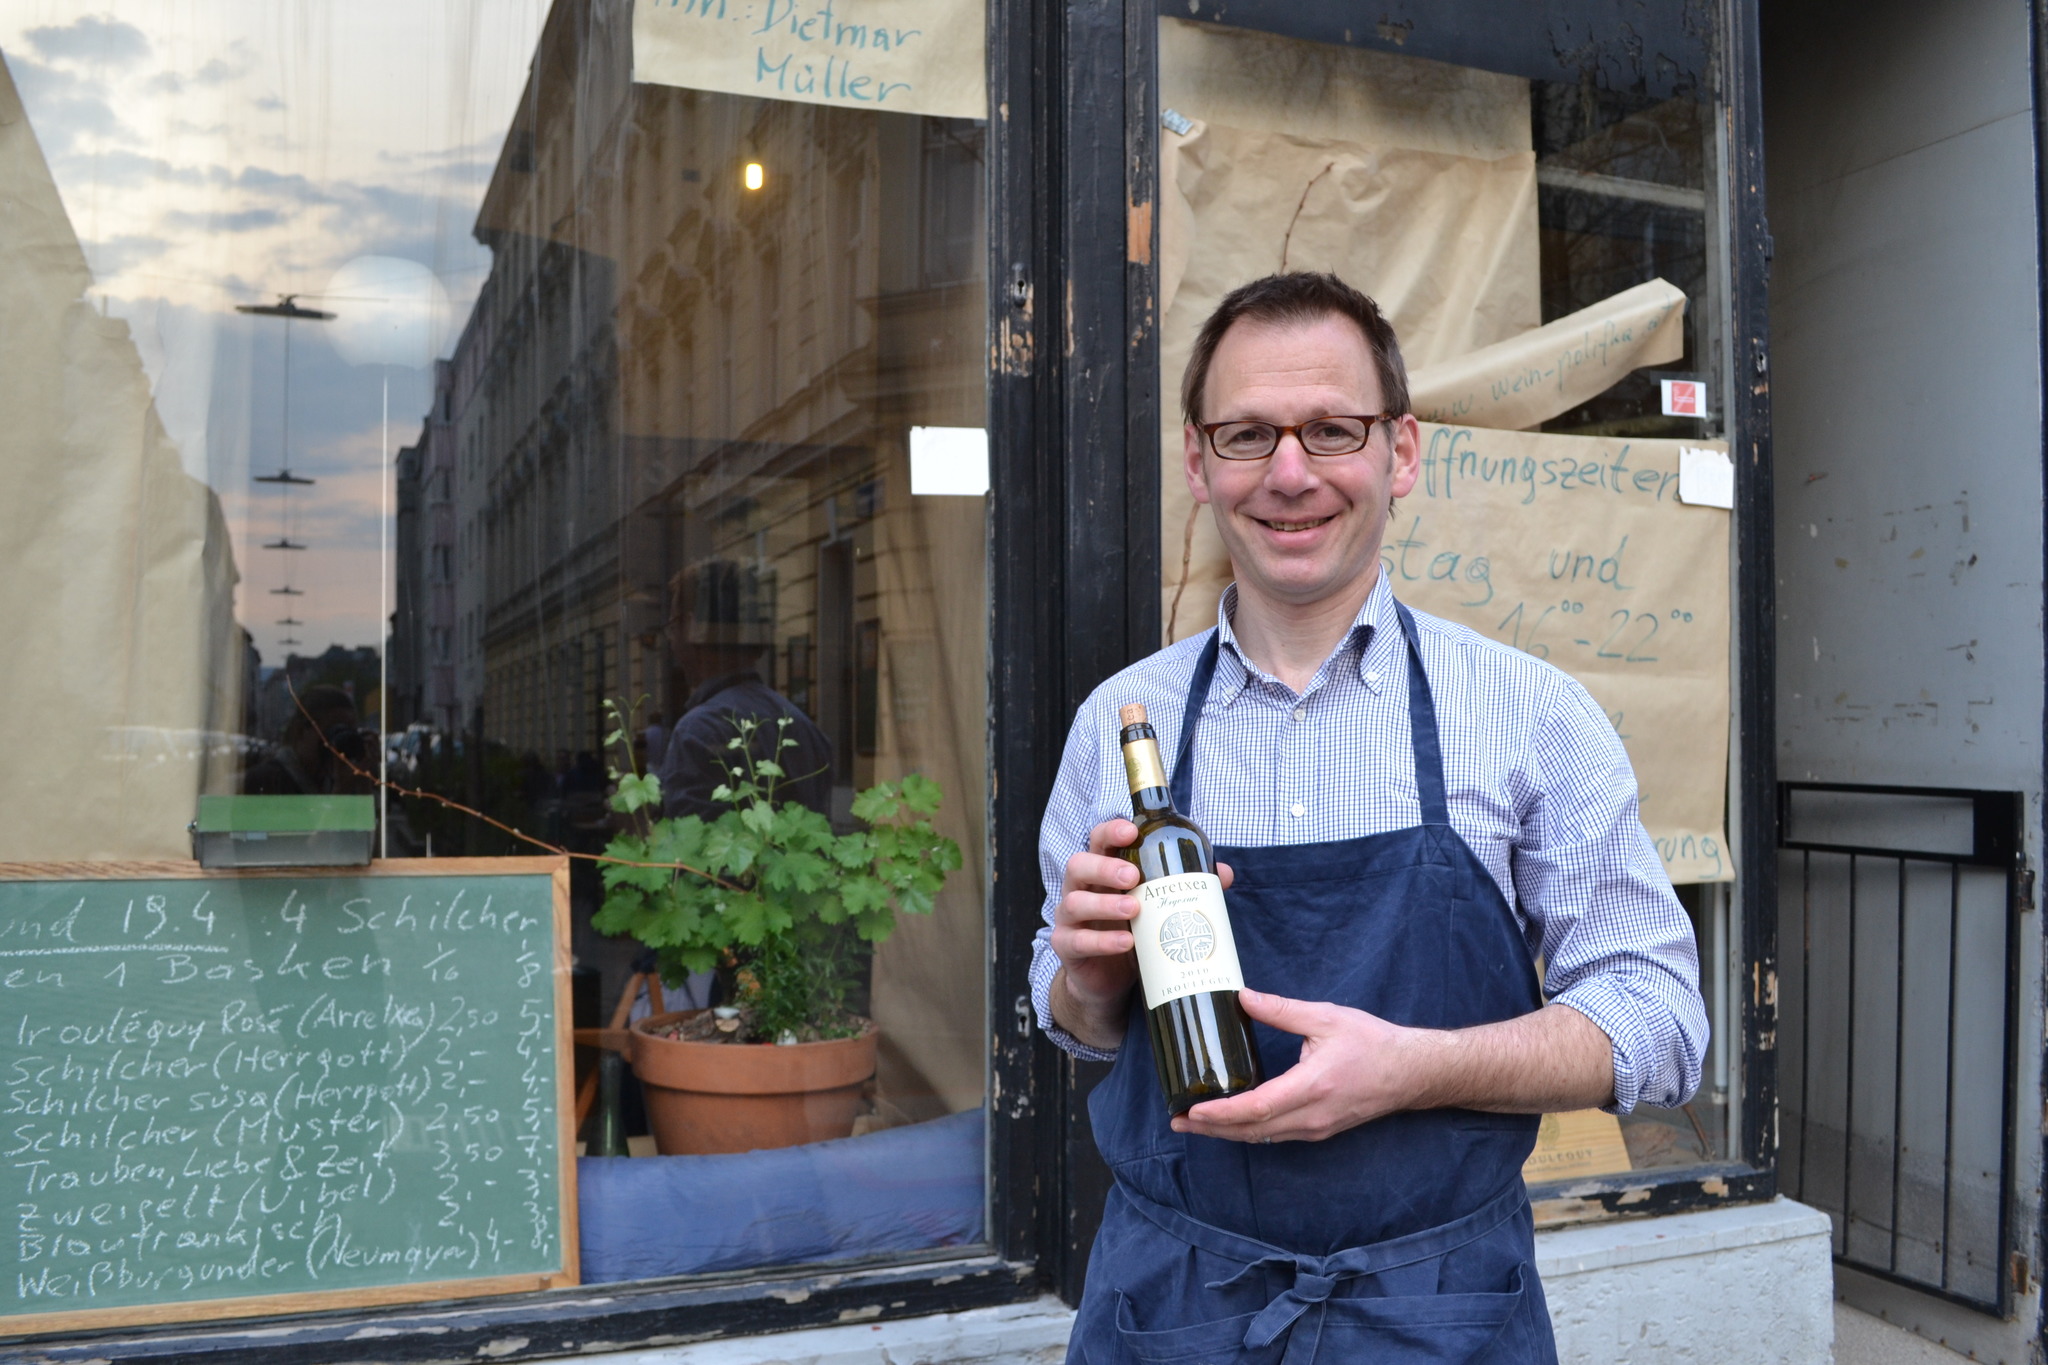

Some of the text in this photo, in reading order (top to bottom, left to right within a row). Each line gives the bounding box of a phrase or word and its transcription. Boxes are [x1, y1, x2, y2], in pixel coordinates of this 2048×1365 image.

[752, 0, 922, 51] Dietmar
[757, 47, 911, 102] Müller
[1421, 426, 1681, 504] ffnungszeiten
[1380, 515, 1636, 607] stag und
[1654, 833, 1723, 880] rung
[280, 889, 306, 934] 4
[337, 888, 539, 934] Schilcher
[1144, 880, 1208, 901] Arretxea
[5, 1050, 208, 1086] Schilcher
[3, 1085, 170, 1116] Schilcher
[4, 1114, 198, 1157] Schilcher
[1528, 1149, 1593, 1166] OULEGUY
